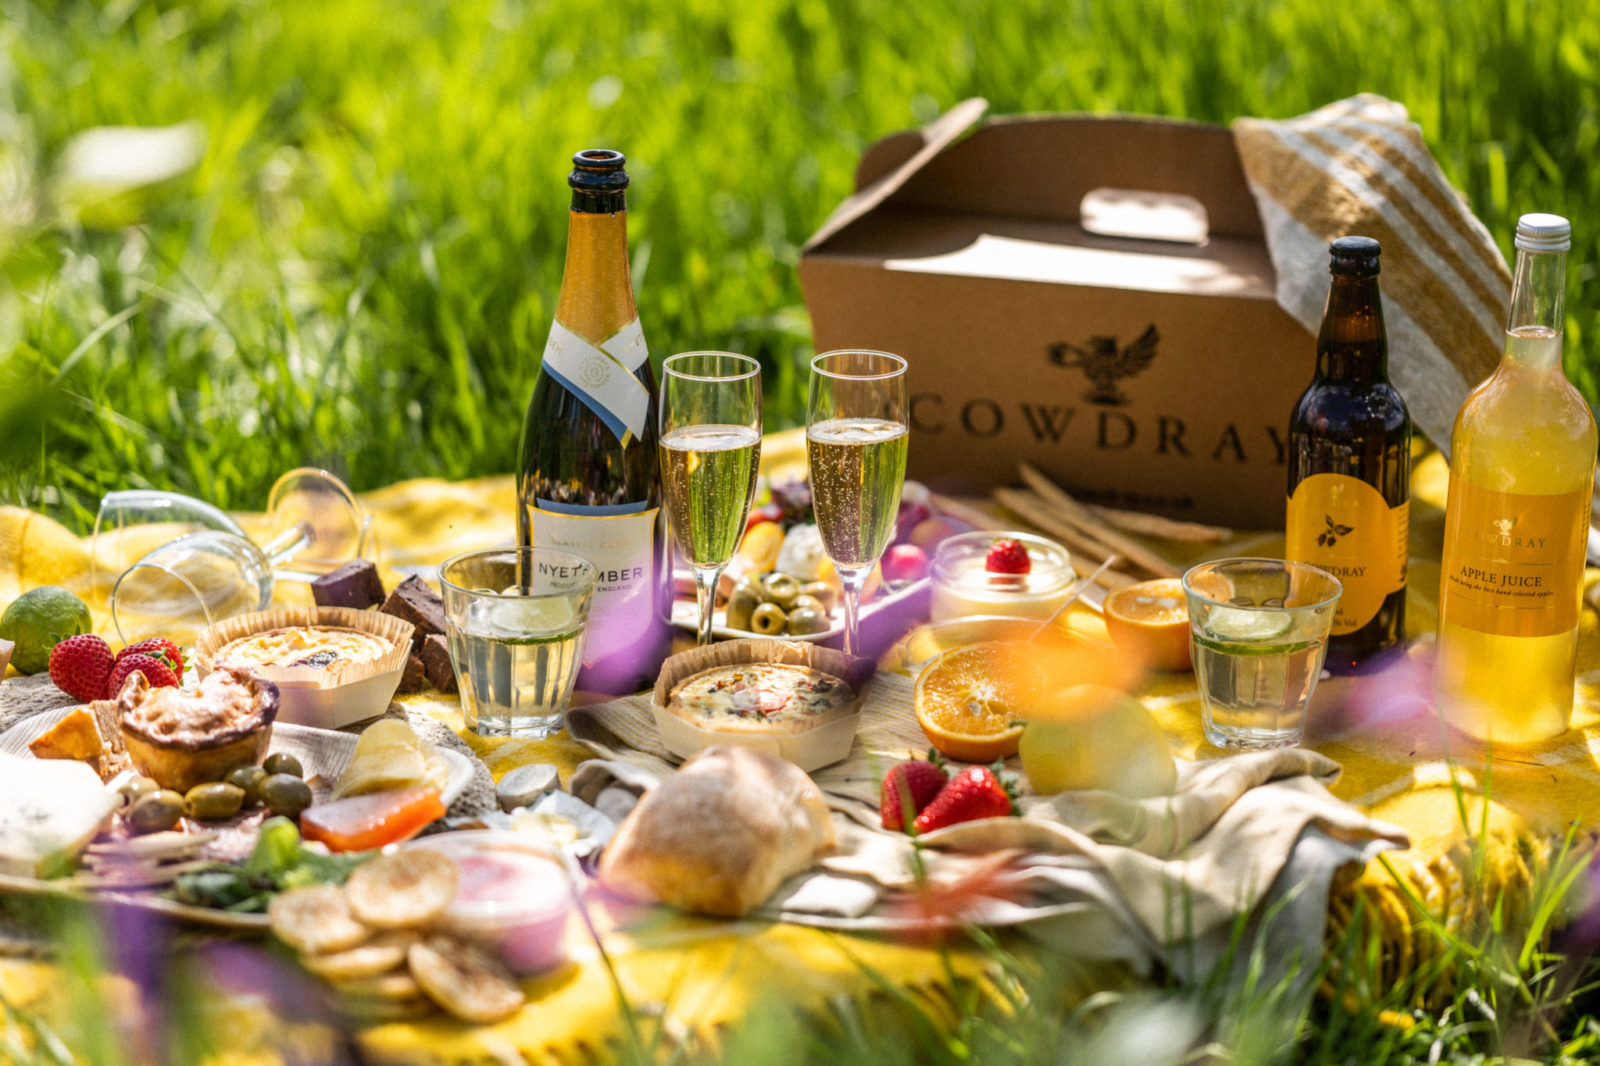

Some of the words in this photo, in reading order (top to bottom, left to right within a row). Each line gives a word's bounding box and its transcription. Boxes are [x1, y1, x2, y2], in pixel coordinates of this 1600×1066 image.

[909, 392, 1288, 464] COWDRAY
[1461, 566, 1497, 584] APPLE
[1501, 575, 1543, 587] JUICE
